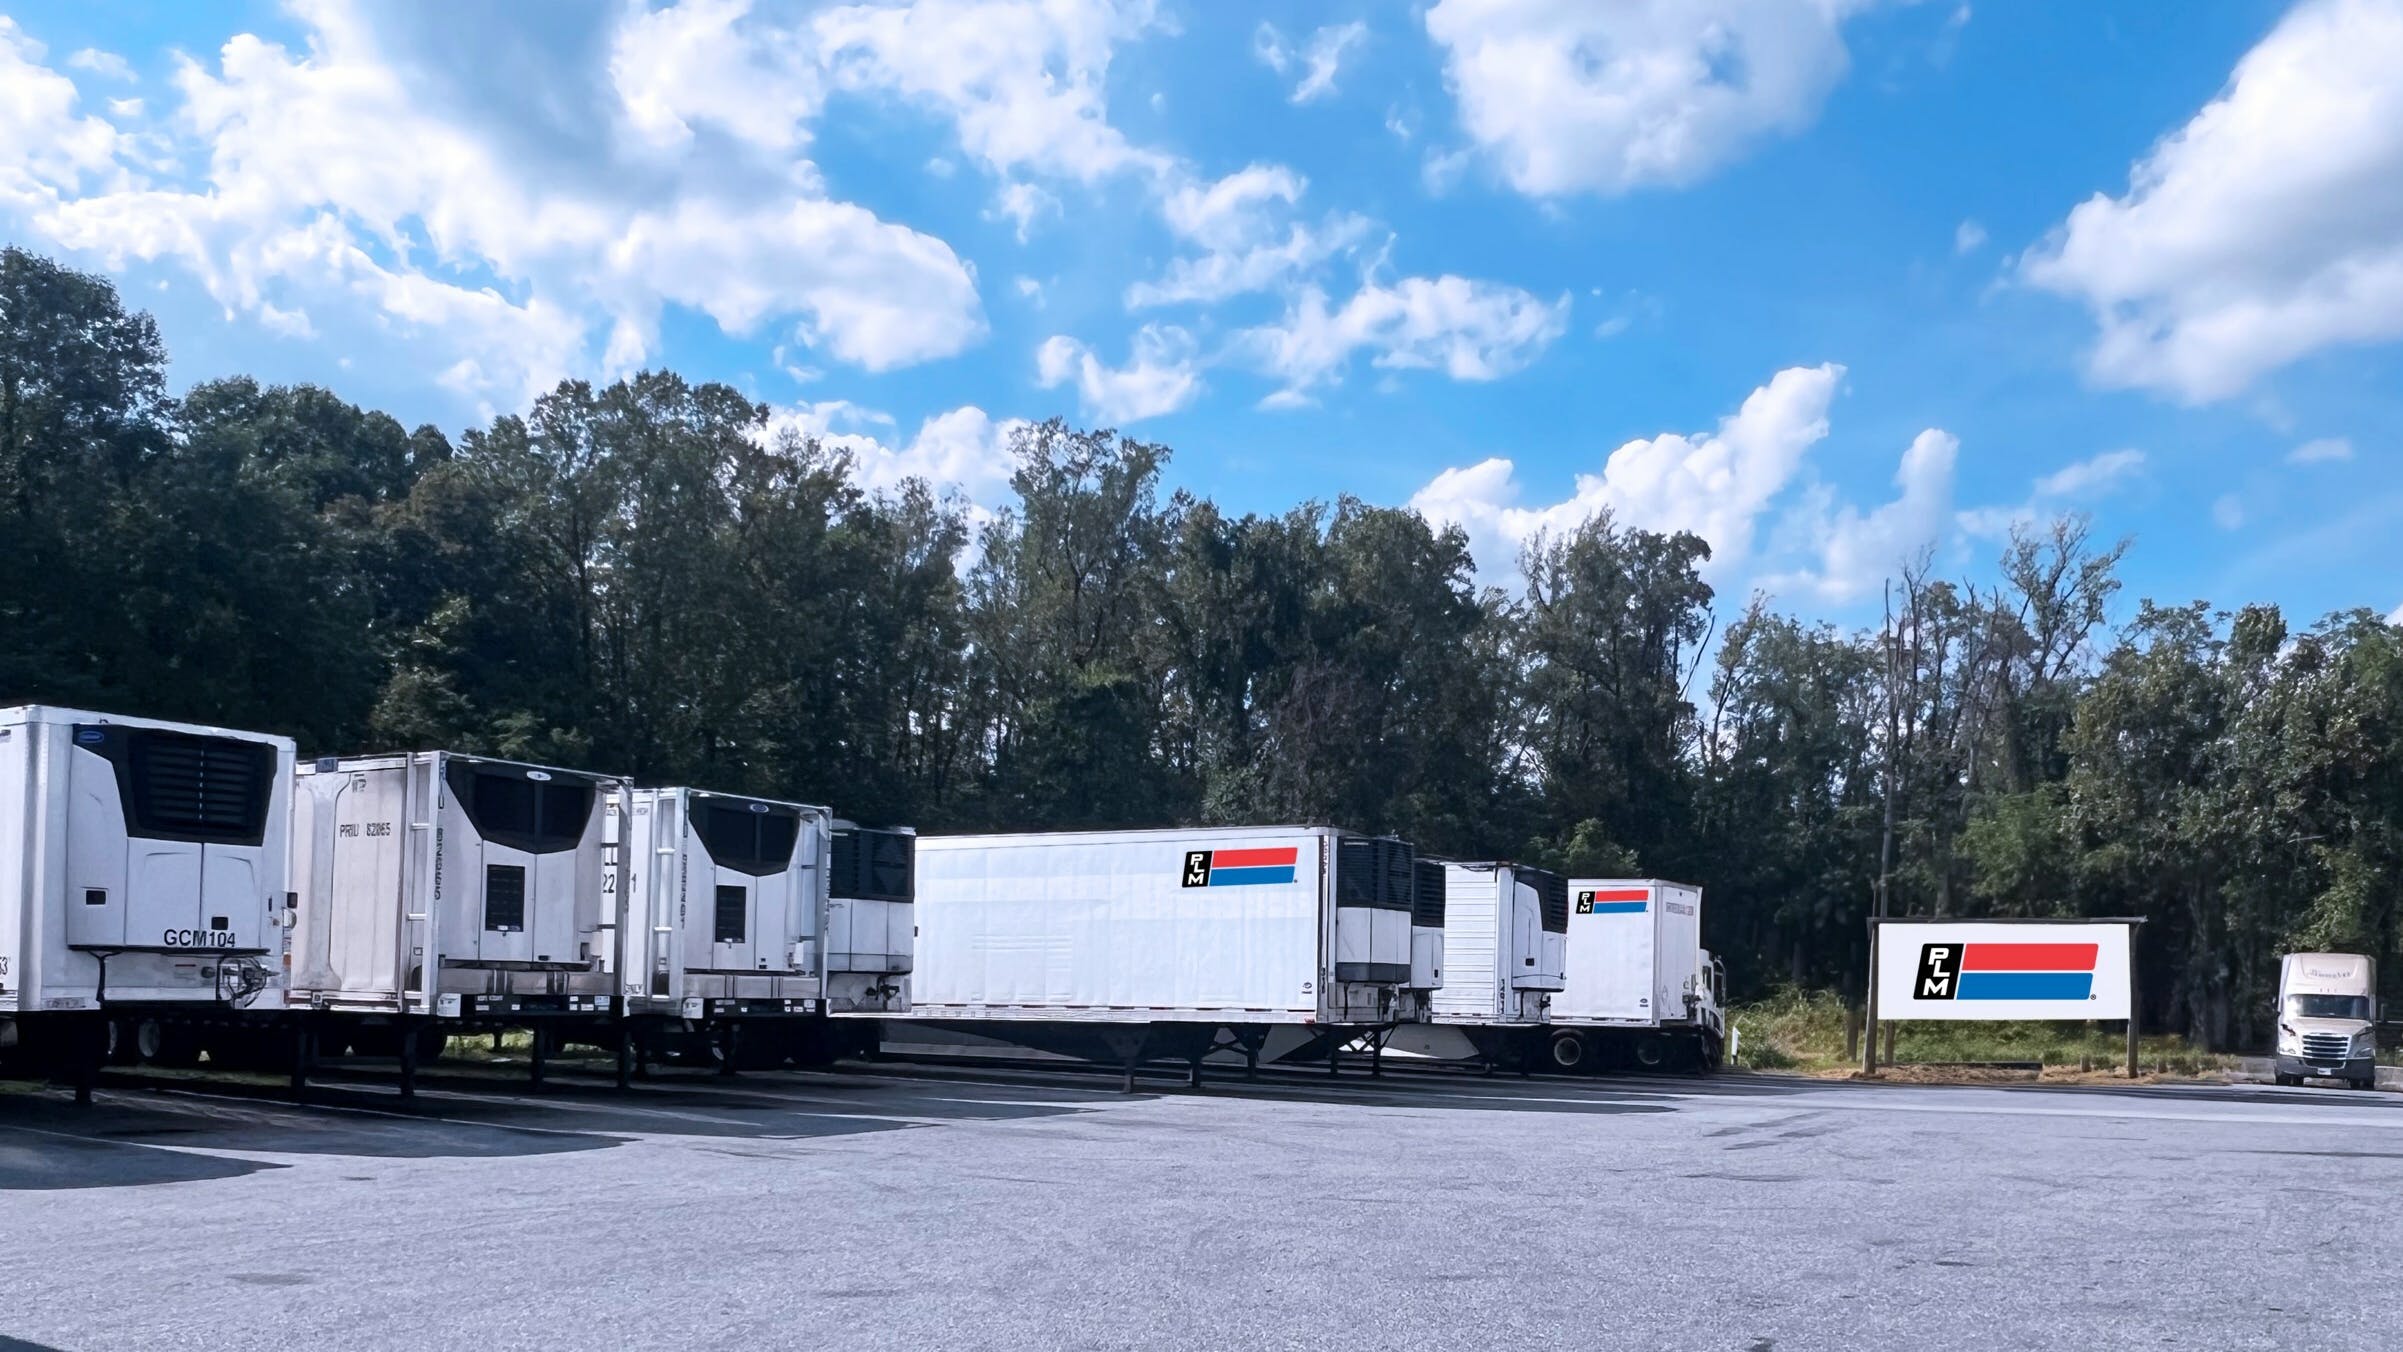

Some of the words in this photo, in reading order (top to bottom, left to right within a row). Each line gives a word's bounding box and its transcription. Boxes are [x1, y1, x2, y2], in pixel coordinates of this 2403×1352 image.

[1187, 853, 1205, 885] PLM
[1579, 892, 1591, 913] PLM
[163, 928, 235, 947] GCM104
[1922, 947, 1951, 996] PLM
